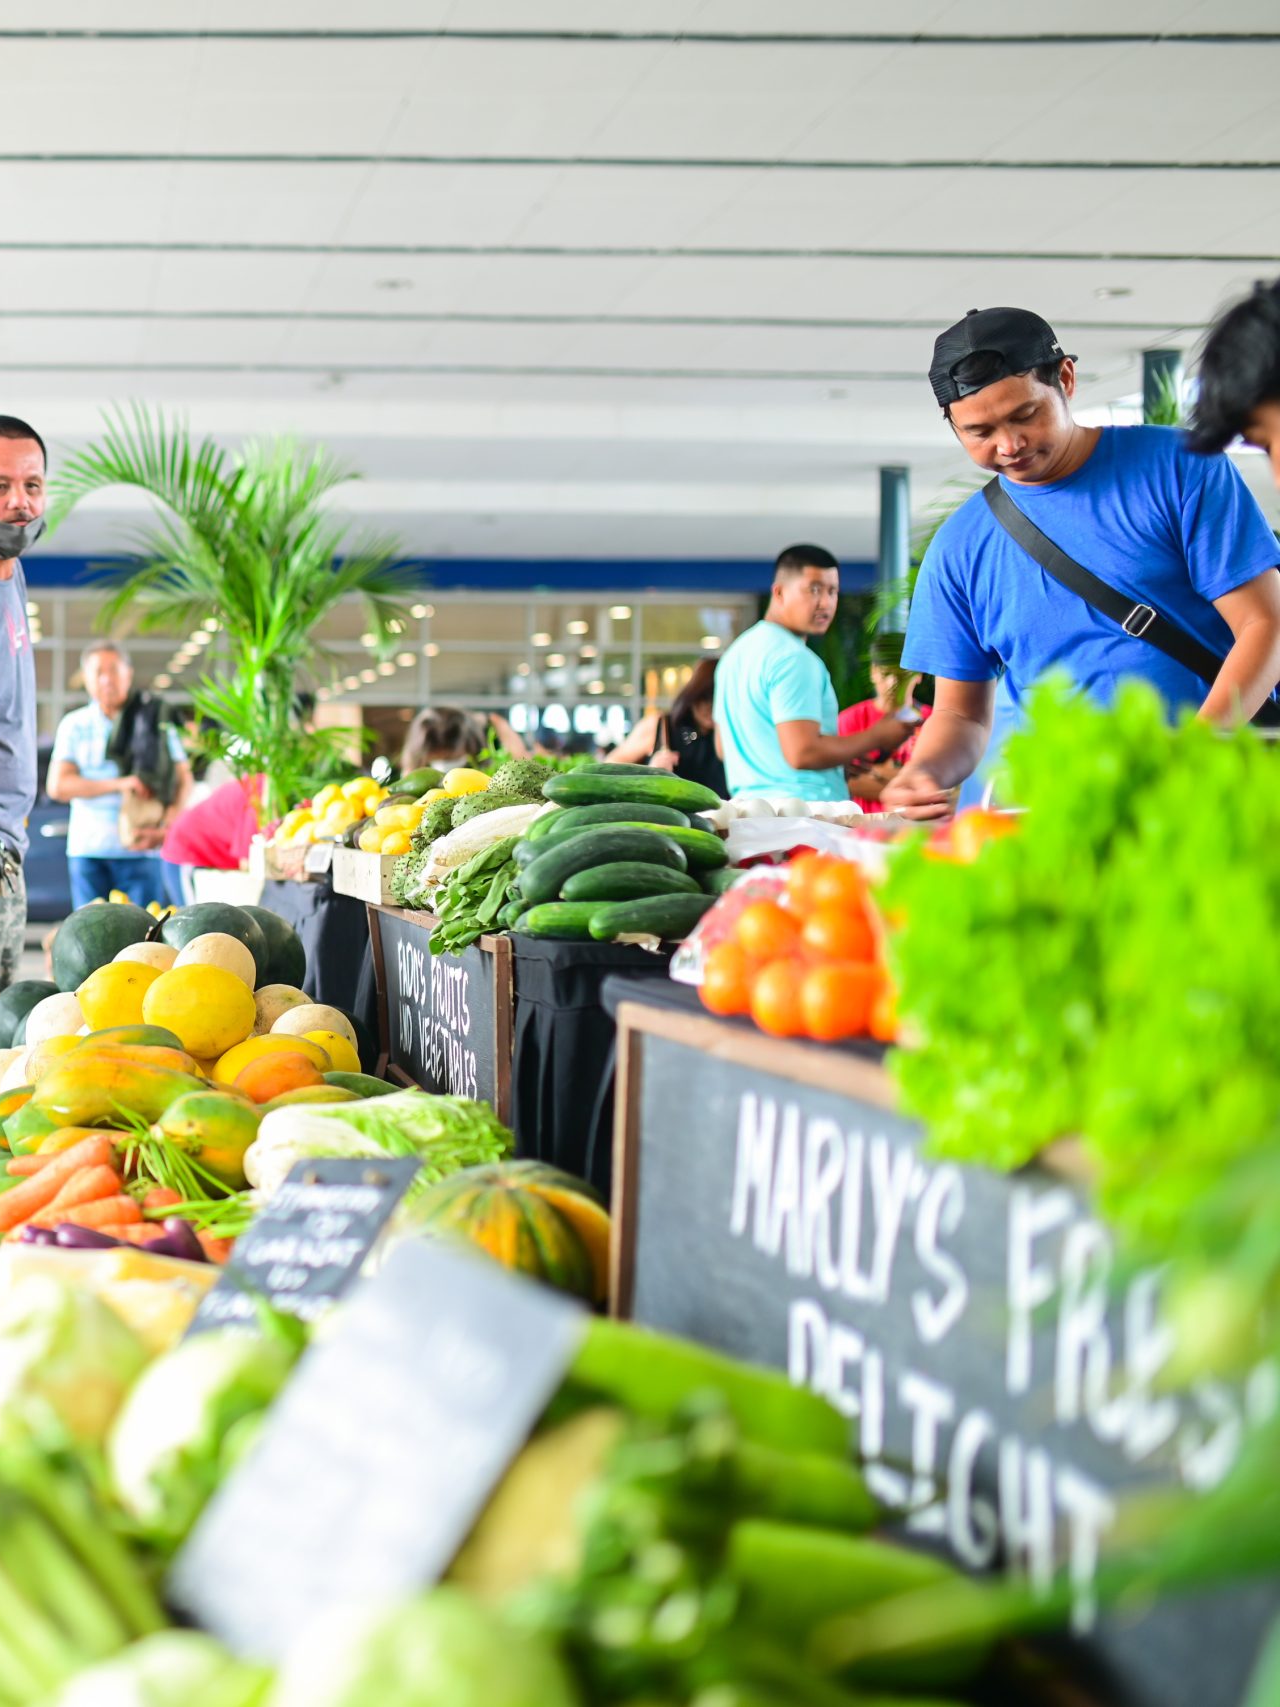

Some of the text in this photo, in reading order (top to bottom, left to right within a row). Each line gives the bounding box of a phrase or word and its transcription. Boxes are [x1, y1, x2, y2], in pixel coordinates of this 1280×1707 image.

[399, 1001, 413, 1055] AND
[431, 955, 470, 1037] FRUITS
[730, 1091, 1280, 1490] MARLY'S FRES
[787, 1299, 1117, 1636] DELIGHT
